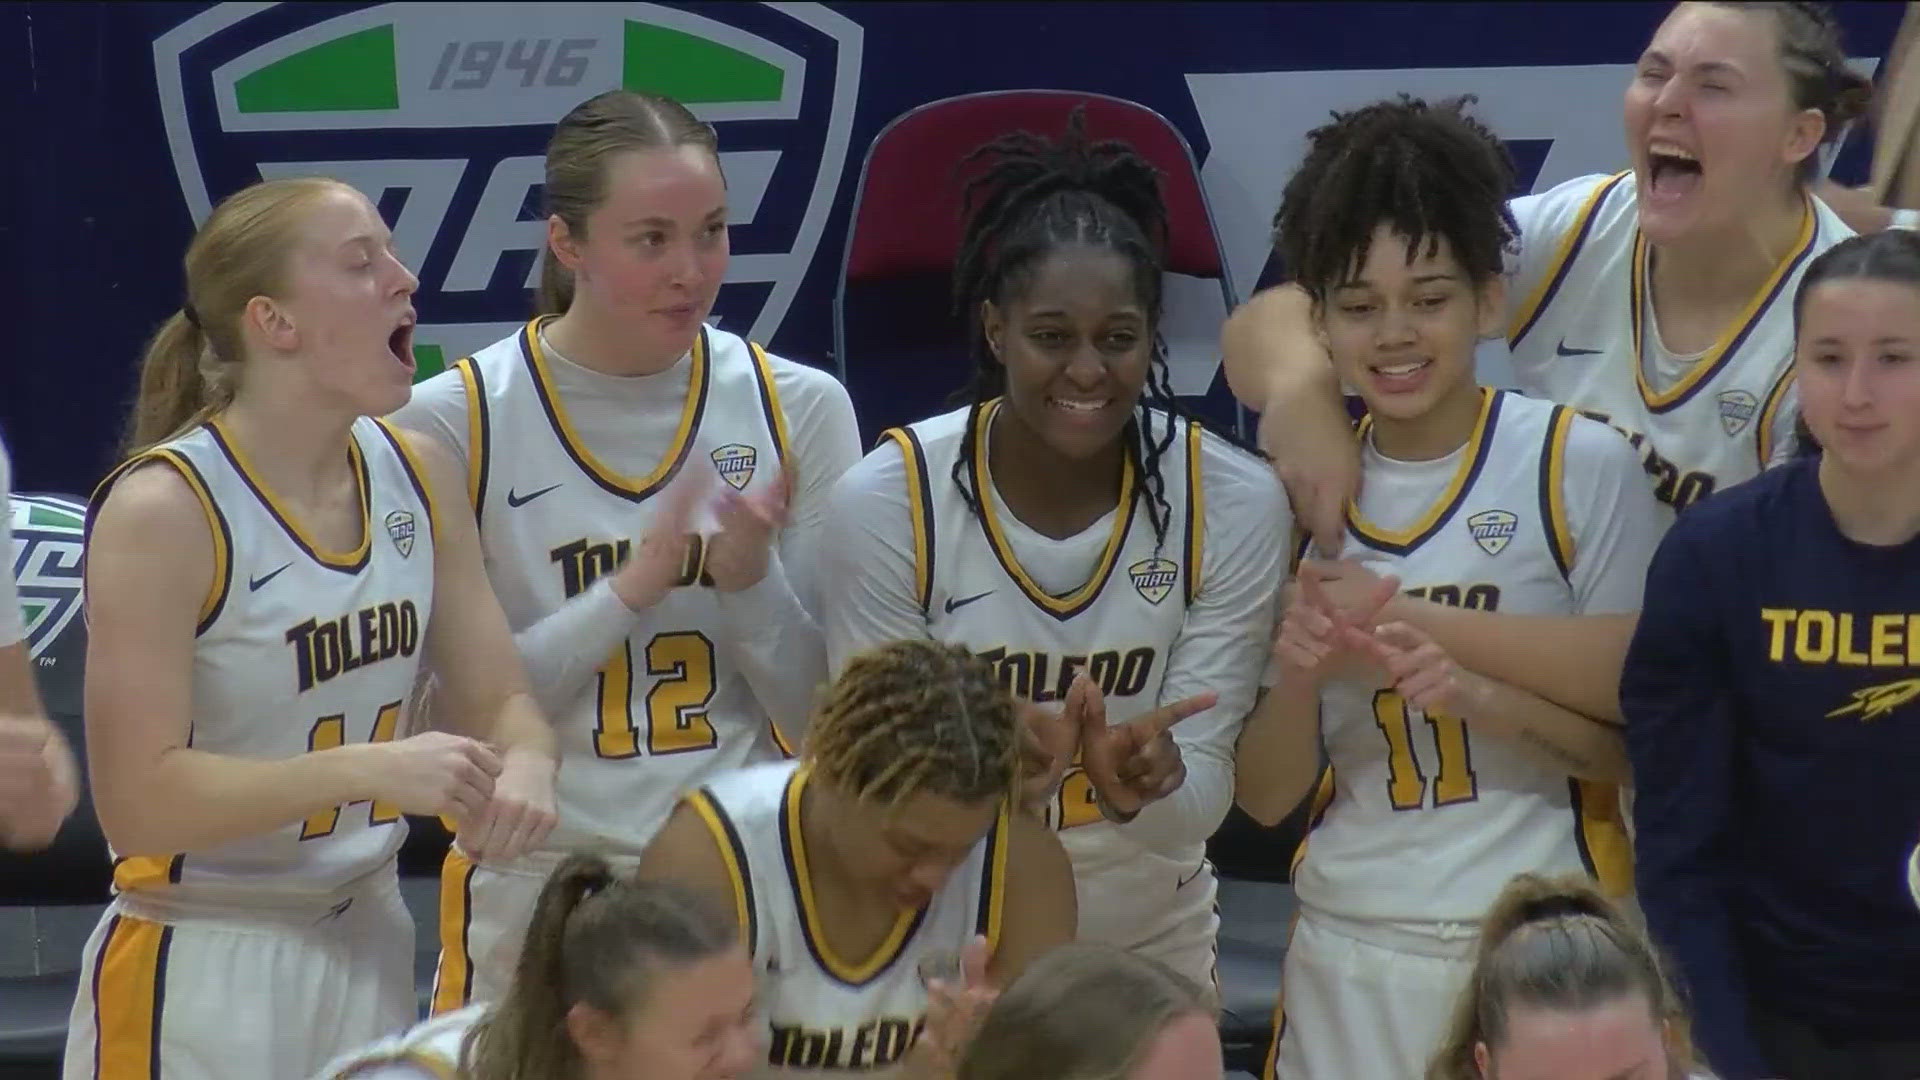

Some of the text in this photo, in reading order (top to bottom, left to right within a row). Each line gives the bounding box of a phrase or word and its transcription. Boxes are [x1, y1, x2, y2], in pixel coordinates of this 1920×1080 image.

[428, 38, 597, 91] 1946
[285, 599, 419, 695] TOLEDO
[1761, 607, 1920, 667] TOLE
[593, 630, 718, 760] 12
[1372, 687, 1478, 812] 11
